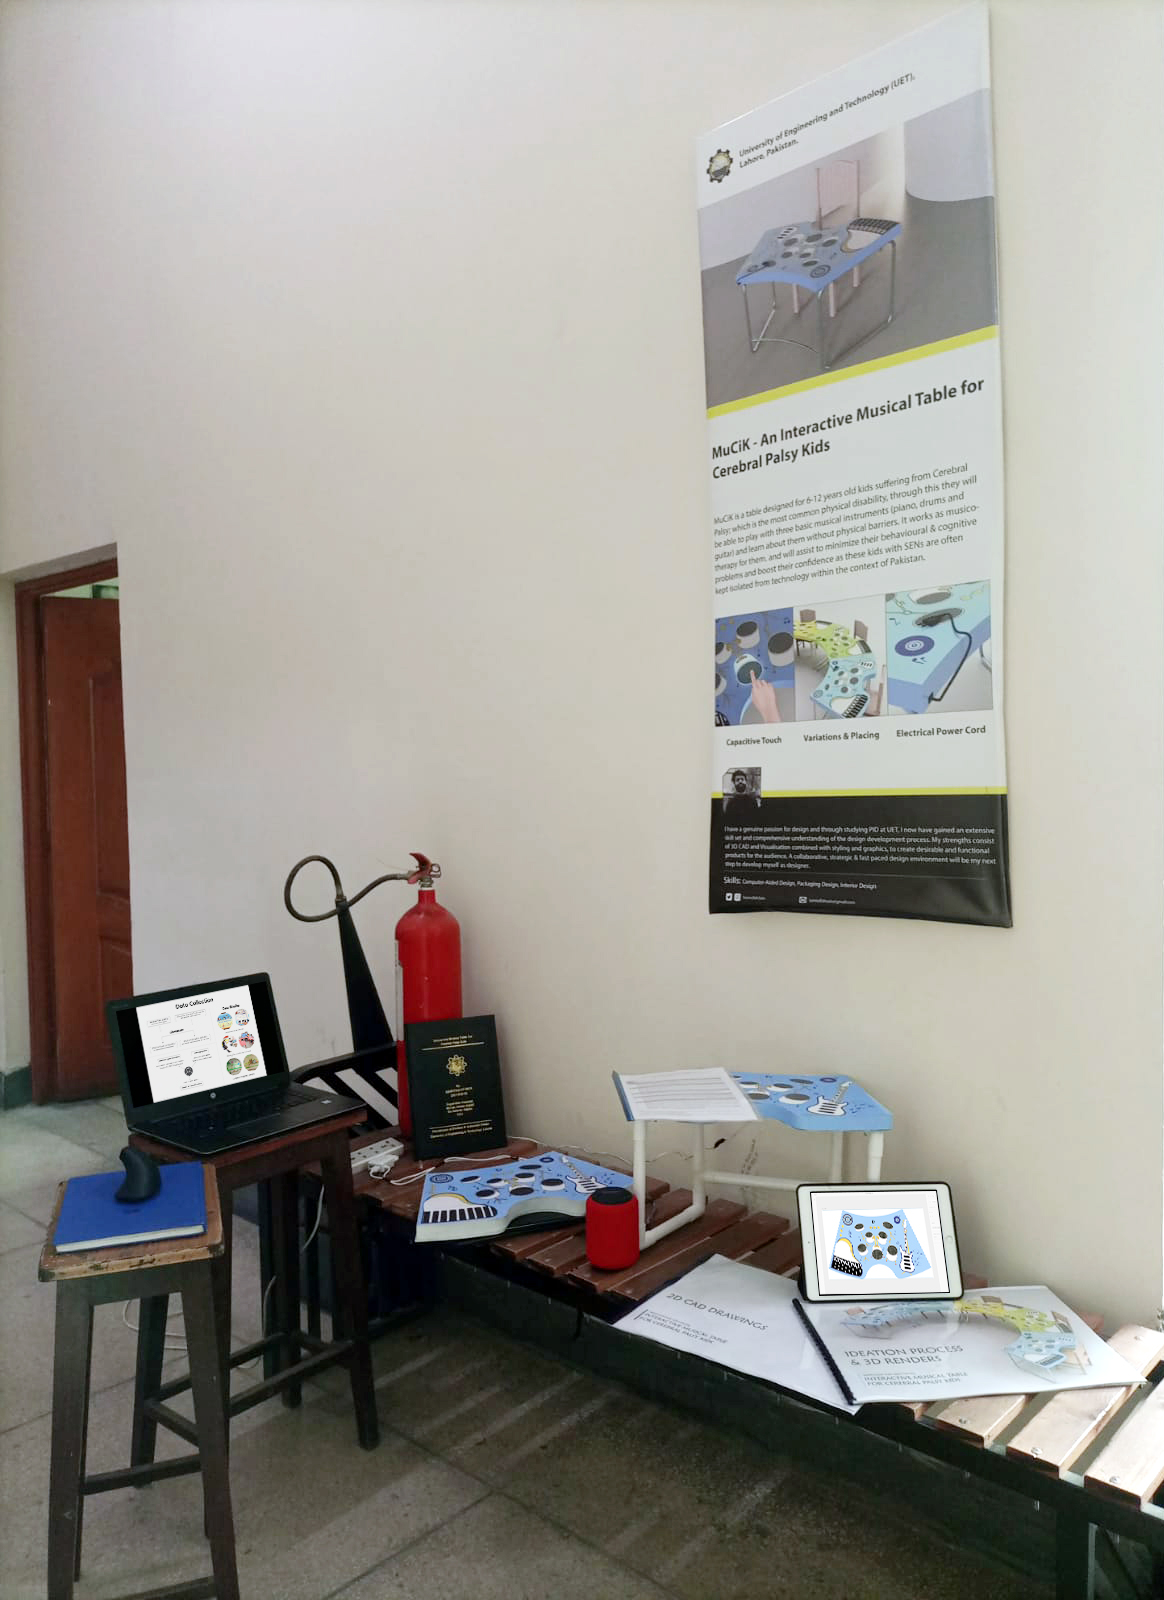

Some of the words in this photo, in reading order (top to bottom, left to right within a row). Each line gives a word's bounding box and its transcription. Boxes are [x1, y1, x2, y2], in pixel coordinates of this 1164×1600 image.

[739, 138, 774, 157] University
[776, 131, 783, 141] of
[784, 113, 828, 137] Engineering
[829, 103, 844, 117] and
[845, 85, 890, 109] Technology
[766, 139, 800, 156] Pakistan.
[712, 438, 751, 459] MuCiK
[760, 433, 778, 446] An
[780, 414, 853, 441] Interactive
[857, 394, 912, 421] Musical
[915, 385, 957, 406] Table
[961, 379, 985, 395] for
[713, 454, 762, 479] Cerebral
[766, 448, 799, 466] Palsy
[802, 439, 831, 456] Kids
[732, 522, 751, 532] which
[770, 514, 788, 524] most
[788, 508, 820, 520] common
[821, 500, 851, 515] physical
[890, 486, 923, 500] through
[924, 484, 940, 493] this
[941, 480, 961, 490] they
[962, 474, 977, 485] will
[746, 508, 762, 518] table
[763, 499, 794, 514] designed
[795, 498, 805, 506] for
[806, 493, 822, 504] 6-12
[823, 491, 843, 502] years
[844, 486, 857, 496] old
[858, 483, 874, 493] kids
[875, 477, 910, 490] suffering
[911, 472, 931, 482] from
[932, 462, 968, 478] Cerebral
[723, 537, 737, 546] able
[745, 533, 758, 543] play
[760, 528, 775, 538] with
[776, 526, 794, 535] three
[795, 522, 813, 532] basic
[814, 514, 842, 528] musical
[843, 507, 889, 521] instruments
[919, 496, 946, 508] drums
[948, 490, 965, 502] and
[735, 546, 748, 556] and
[748, 544, 765, 552] learn
[766, 539, 786, 550] about
[787, 536, 806, 545] them
[806, 530, 835, 542] without
[836, 523, 867, 538] physical
[901, 516, 908, 524] It
[909, 511, 934, 522] works
[935, 510, 944, 518] as
[714, 562, 738, 571] therapy
[739, 558, 748, 566] for
[768, 551, 782, 561] and
[783, 548, 795, 558] will
[796, 545, 815, 556] assist
[825, 539, 860, 550] minimize
[861, 534, 879, 544] their
[880, 525, 928, 541] behavioural
[930, 524, 937, 533] &
[938, 518, 977, 532] cognitive
[714, 572, 744, 584] problems
[744, 568, 757, 578] and
[757, 565, 777, 575] boost
[777, 563, 793, 571] their
[795, 556, 834, 568] confidence
[835, 554, 844, 562] as
[845, 551, 867, 560] these
[868, 546, 884, 556] kids
[885, 543, 903, 553] with
[904, 540, 924, 550] SENs
[926, 538, 939, 547] are
[940, 534, 964, 544] often
[715, 586, 729, 594] kept
[729, 581, 754, 592] isolated
[755, 579, 771, 587] from
[771, 572, 810, 584] technology
[811, 568, 835, 578] within
[836, 565, 849, 574] the
[850, 561, 879, 572] context
[880, 558, 889, 567] of
[890, 554, 926, 566] Pakistan.
[726, 737, 761, 747] Capacitive
[761, 735, 783, 744] Touch
[803, 733, 842, 742] Variations
[843, 732, 849, 740] &
[851, 731, 880, 740] Placing
[896, 727, 935, 737] Electrical
[936, 727, 964, 735] Power
[965, 724, 986, 734] Cord
[942, 836, 973, 845] strengths
[957, 846, 990, 854] functional
[684, 1299, 707, 1310] CAD
[708, 1308, 768, 1330] DRAWINGS
[845, 1348, 907, 1358] IDEATION
[910, 1345, 964, 1354] PROCESS
[864, 1358, 881, 1366] 3D
[884, 1356, 942, 1364] RENDERS
